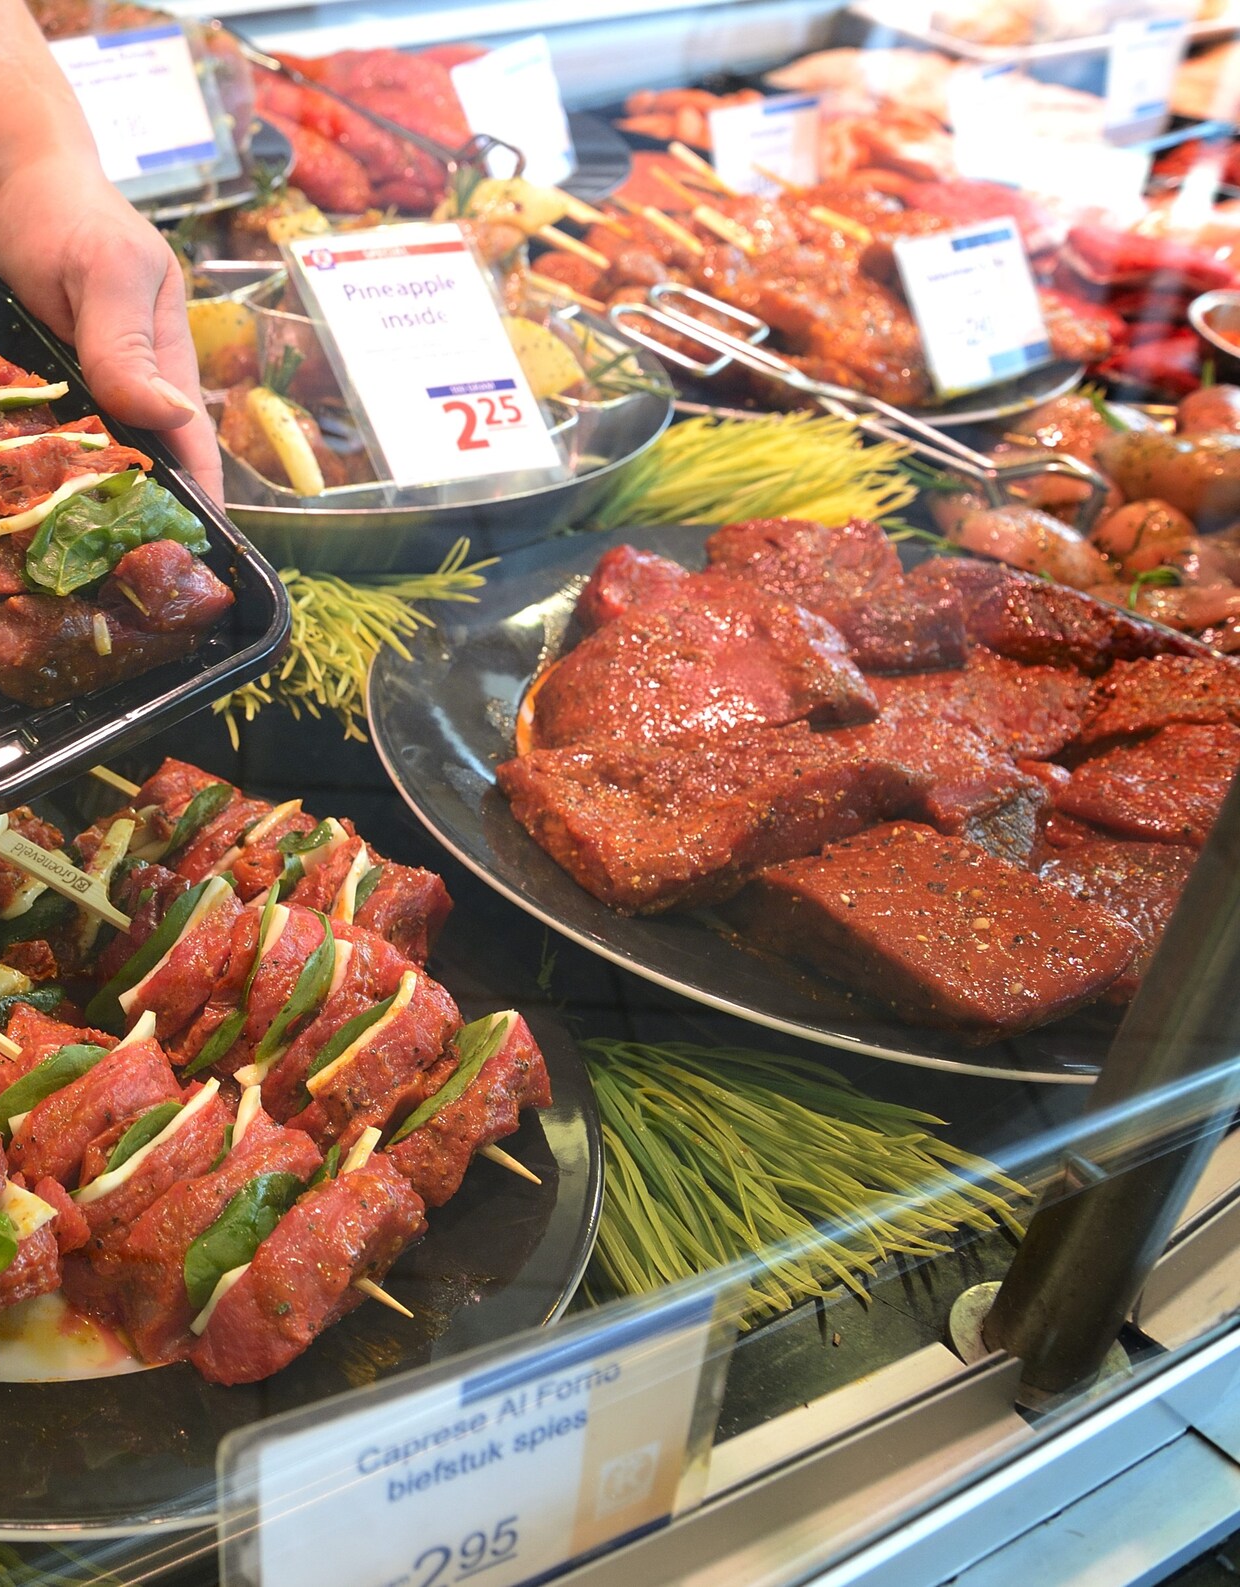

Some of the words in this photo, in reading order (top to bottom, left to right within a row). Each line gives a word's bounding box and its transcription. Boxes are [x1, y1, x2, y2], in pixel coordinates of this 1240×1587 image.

[342, 273, 456, 302] Pineapple
[378, 305, 449, 330] inside
[10, 842, 78, 885] Groeneveld
[357, 1411, 488, 1475] Caprese
[496, 1392, 527, 1424] Al
[536, 1362, 622, 1409] Forno
[387, 1440, 503, 1502] biefstuk
[513, 1408, 589, 1454] spies
